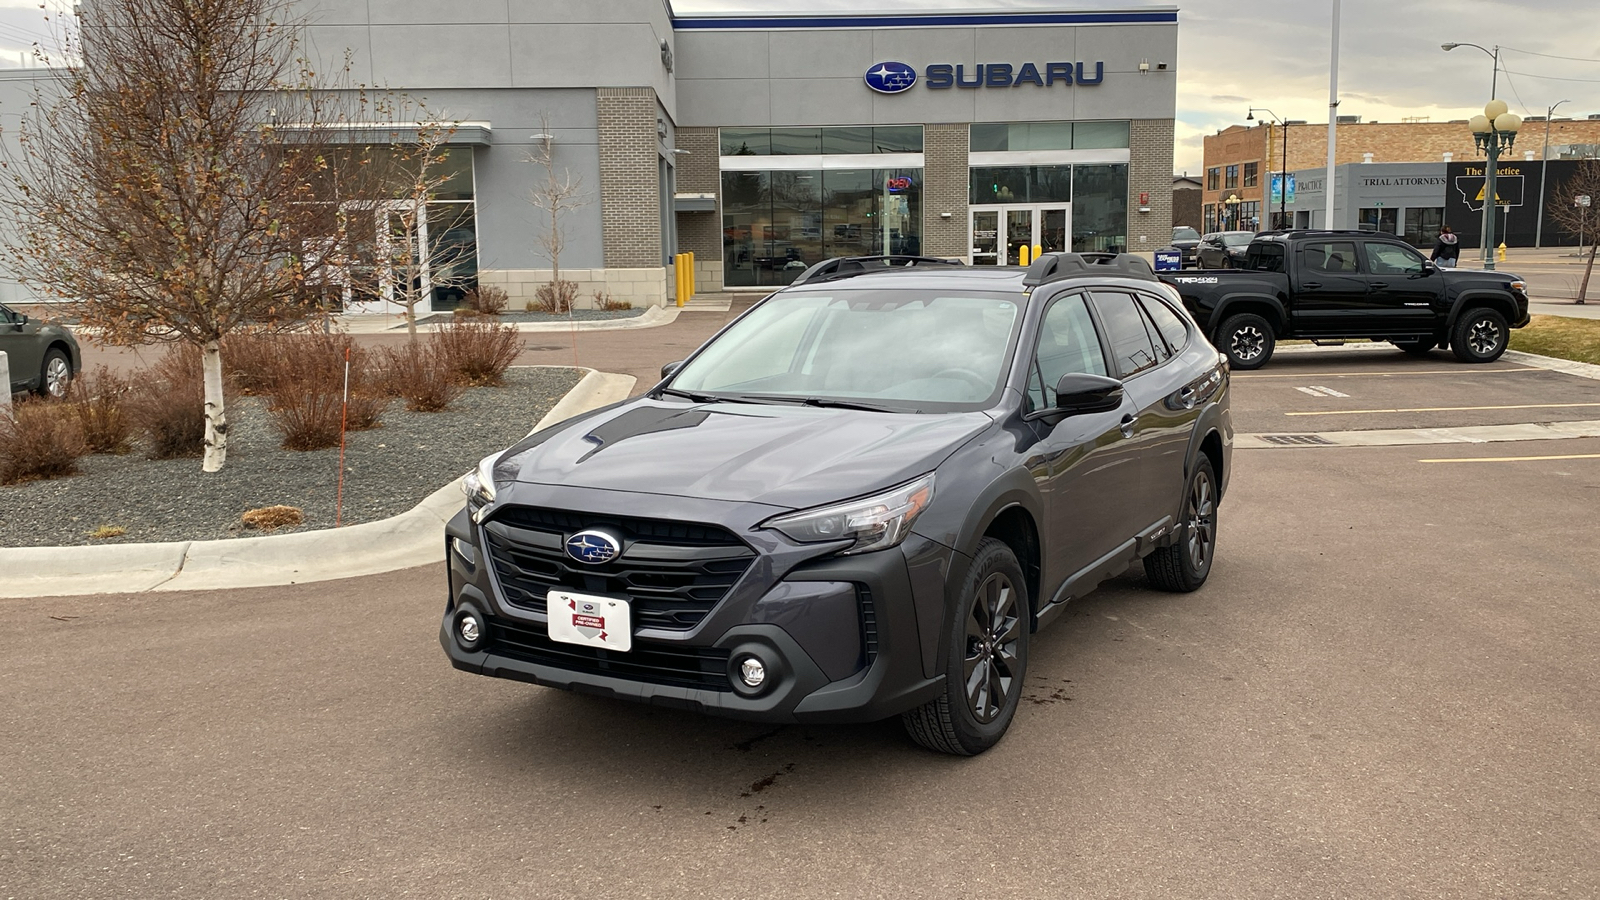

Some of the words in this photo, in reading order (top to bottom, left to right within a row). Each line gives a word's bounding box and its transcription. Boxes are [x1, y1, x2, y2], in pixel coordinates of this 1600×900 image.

[926, 61, 1104, 89] SUBARU
[1465, 167, 1483, 176] The
[1298, 179, 1322, 191] PRACTICE
[1363, 178, 1391, 186] TRIAL
[1393, 177, 1446, 186] ATTORNEYS
